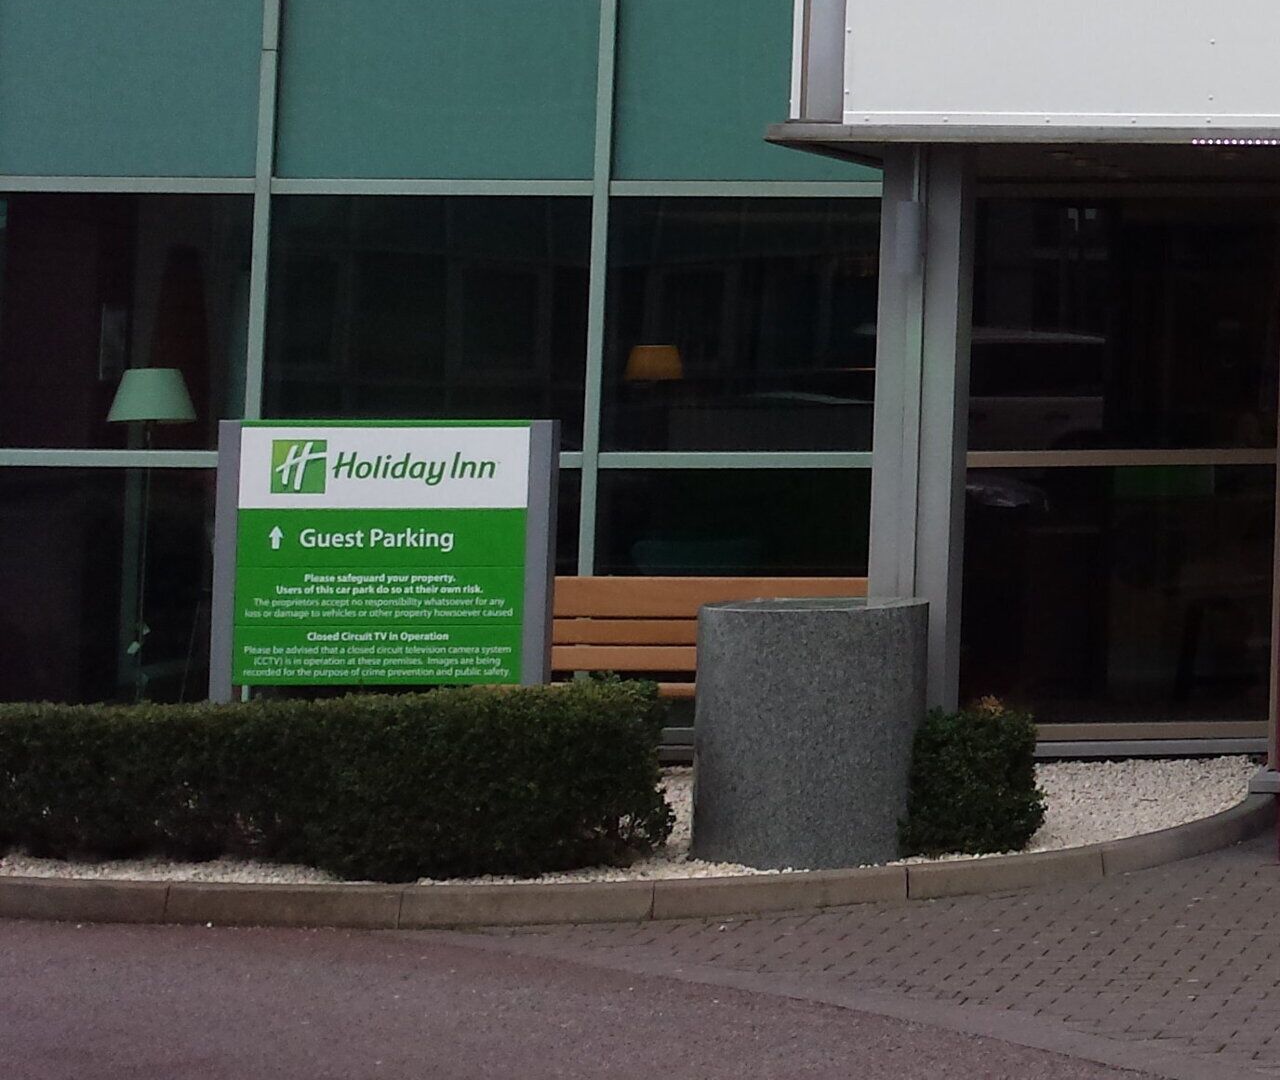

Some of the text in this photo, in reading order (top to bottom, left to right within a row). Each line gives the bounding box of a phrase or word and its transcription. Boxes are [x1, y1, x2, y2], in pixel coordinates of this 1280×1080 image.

[332, 451, 496, 486] Holiday Inn
[299, 528, 454, 553] Guest Parking
[304, 573, 335, 582] Please
[337, 573, 385, 584] safeguard
[387, 575, 409, 584] your
[276, 585, 302, 594] Users
[304, 585, 314, 594] of
[316, 585, 334, 594] this
[352, 585, 374, 596] park
[376, 585, 389, 594] do
[404, 585, 413, 594] at
[416, 584, 438, 594] their
[463, 584, 483, 593] risk.
[254, 598, 269, 606] The
[272, 598, 319, 608] proprietors
[321, 598, 349, 608] accept
[365, 598, 422, 607] responsibility
[424, 597, 473, 605] whatsoever
[475, 597, 487, 605] for
[489, 599, 505, 607] any
[245, 609, 261, 618] loss
[274, 609, 309, 619] damage
[311, 609, 320, 617] to
[322, 609, 356, 617] vehicles
[369, 609, 392, 617] other
[394, 608, 432, 618] property
[434, 608, 480, 616] howsoever
[483, 608, 513, 616] caused
[307, 632, 449, 642] Closed Circuit TV in Operation
[244, 646, 271, 654] Please
[273, 646, 284, 654] be
[285, 646, 319, 654] advised
[321, 646, 338, 654] that
[347, 646, 375, 654] closed
[377, 646, 402, 654] circuit
[405, 645, 446, 653] television
[482, 645, 511, 655] system
[254, 658, 282, 667] (CCTV)
[285, 658, 292, 666] is
[294, 658, 301, 666] in
[304, 657, 345, 667] operation
[347, 657, 356, 665] at
[358, 657, 381, 665] these
[427, 657, 458, 666] Images
[476, 656, 501, 666] being
[243, 669, 281, 677] recorded
[283, 669, 295, 677] for
[297, 669, 311, 677] the
[351, 668, 360, 676] of
[362, 668, 385, 676] crime
[388, 668, 434, 678] prevention
[436, 668, 453, 676] and
[455, 668, 481, 677] public
